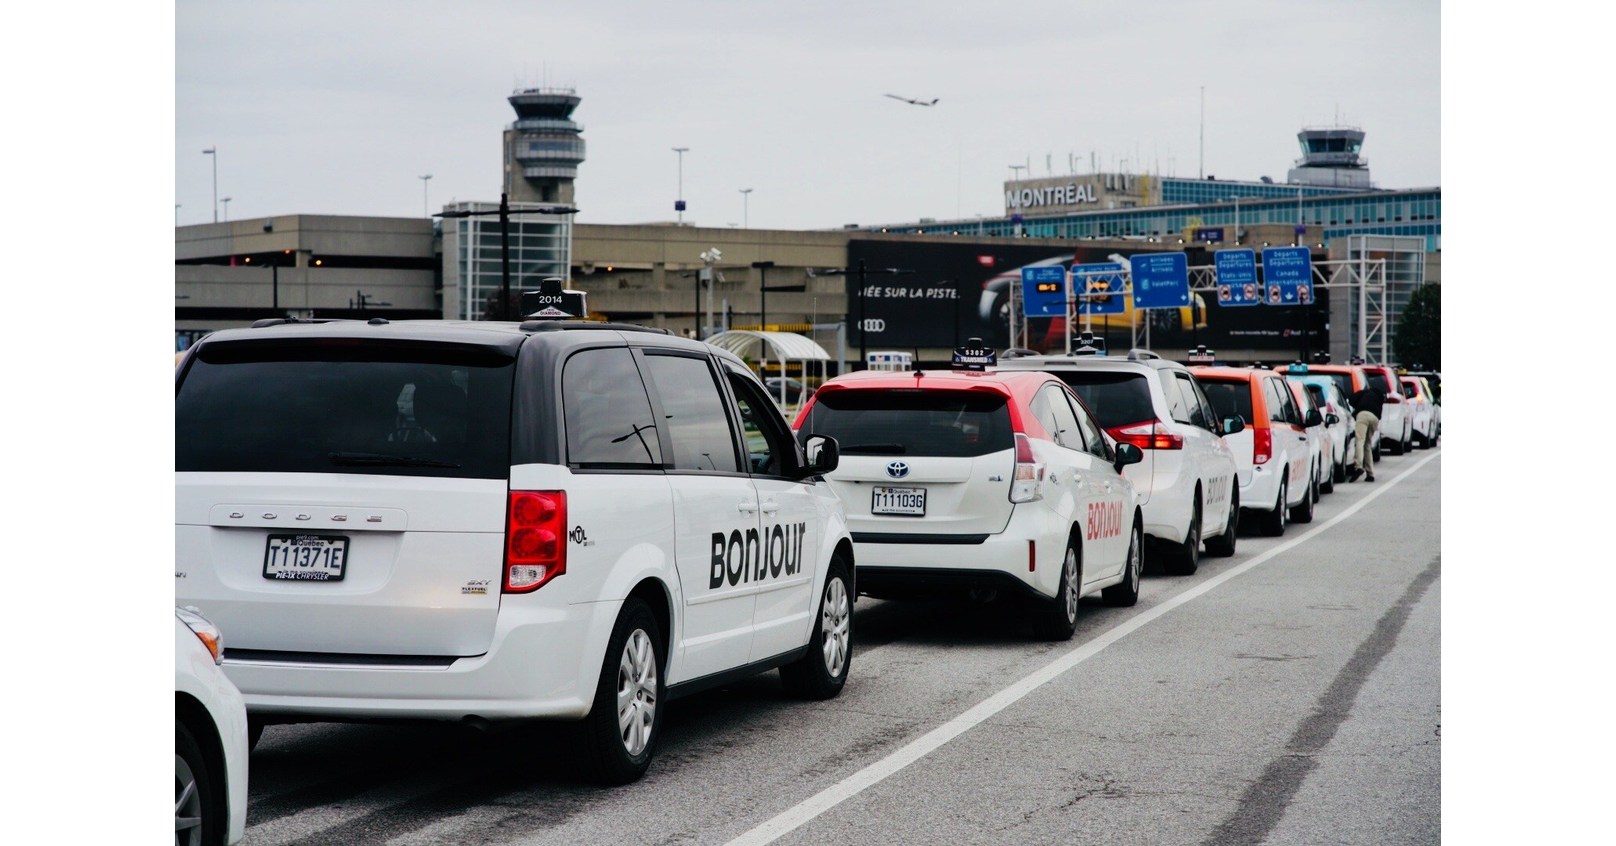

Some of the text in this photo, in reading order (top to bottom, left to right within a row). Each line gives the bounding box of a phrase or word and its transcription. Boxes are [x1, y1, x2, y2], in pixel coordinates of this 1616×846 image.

[1006, 183, 1097, 208] MONTRÉAL
[884, 287, 907, 298] SUR
[909, 288, 923, 298] LA
[539, 295, 563, 304] 2014
[875, 493, 923, 508] T11103G
[229, 511, 382, 523] DODGE
[271, 545, 342, 568] T11371E
